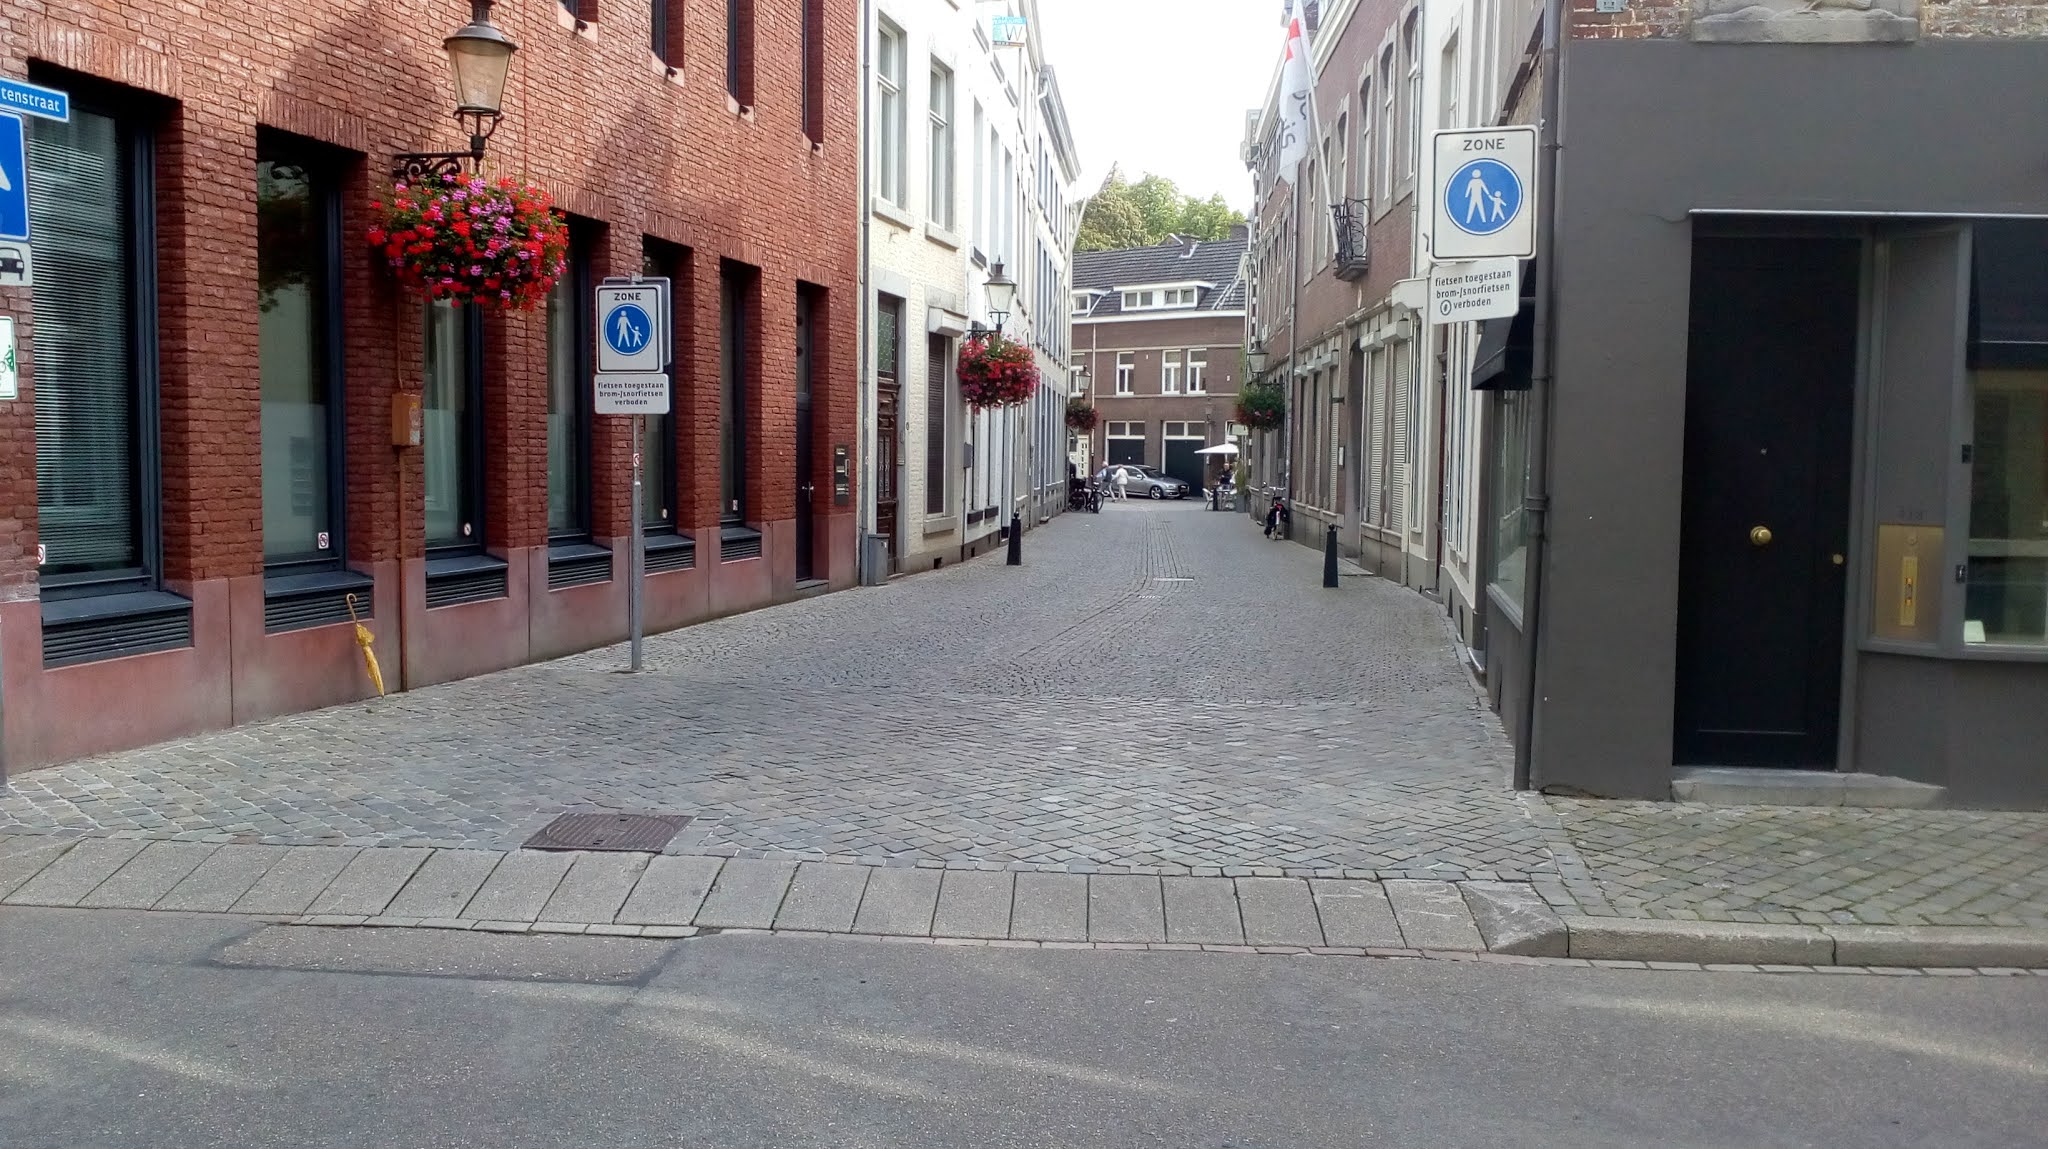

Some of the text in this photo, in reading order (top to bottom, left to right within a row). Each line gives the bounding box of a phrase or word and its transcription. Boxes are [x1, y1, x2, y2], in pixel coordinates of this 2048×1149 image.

[1, 86, 60, 112] tenstraat
[1463, 138, 1506, 151] ZONE
[1435, 270, 1512, 287] fietsen toegestaan
[614, 292, 642, 301] ZONE
[1436, 283, 1510, 299] brom-/snorfietsen
[1453, 298, 1492, 309] verboden
[624, 382, 664, 390] toegestaan
